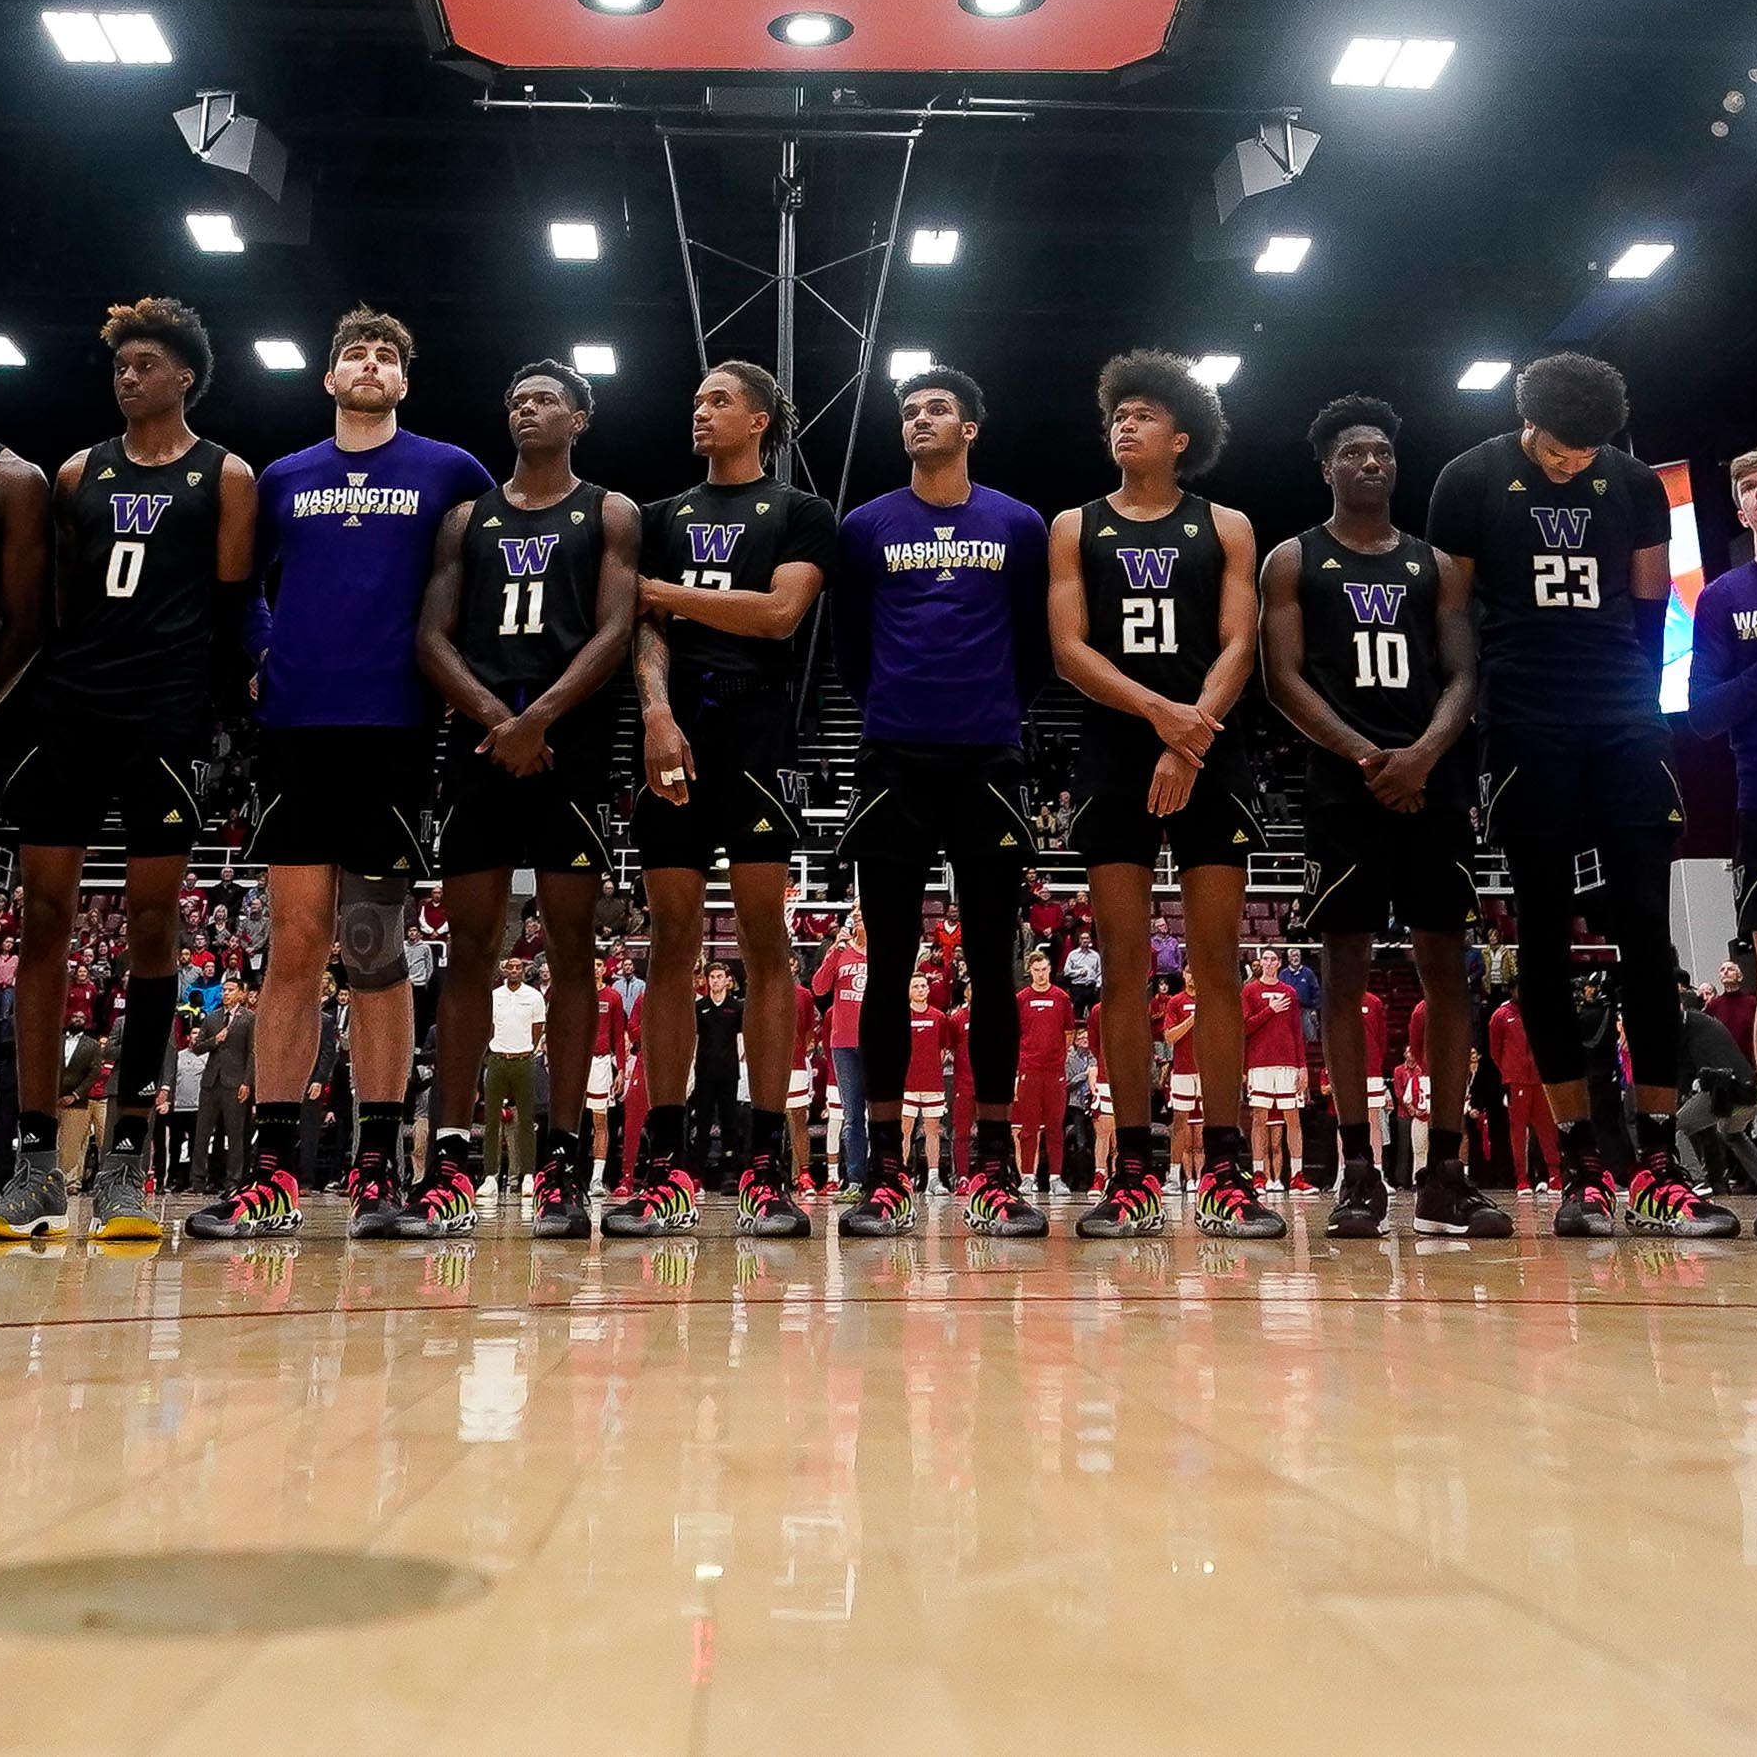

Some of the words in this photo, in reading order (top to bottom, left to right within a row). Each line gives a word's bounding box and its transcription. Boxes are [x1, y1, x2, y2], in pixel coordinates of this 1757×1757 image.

[110, 493, 173, 535] W
[294, 488, 420, 510] WASHINGTON
[687, 523, 745, 563] W
[1530, 507, 1592, 549] W
[106, 541, 145, 598] 0
[498, 534, 560, 576] W
[884, 540, 1006, 563] WASHINGTON
[1116, 548, 1179, 589] W
[1533, 555, 1601, 609] 23
[499, 581, 545, 636] 11
[1344, 583, 1407, 625] W
[1122, 598, 1179, 654] 21
[1353, 631, 1411, 689] 10
